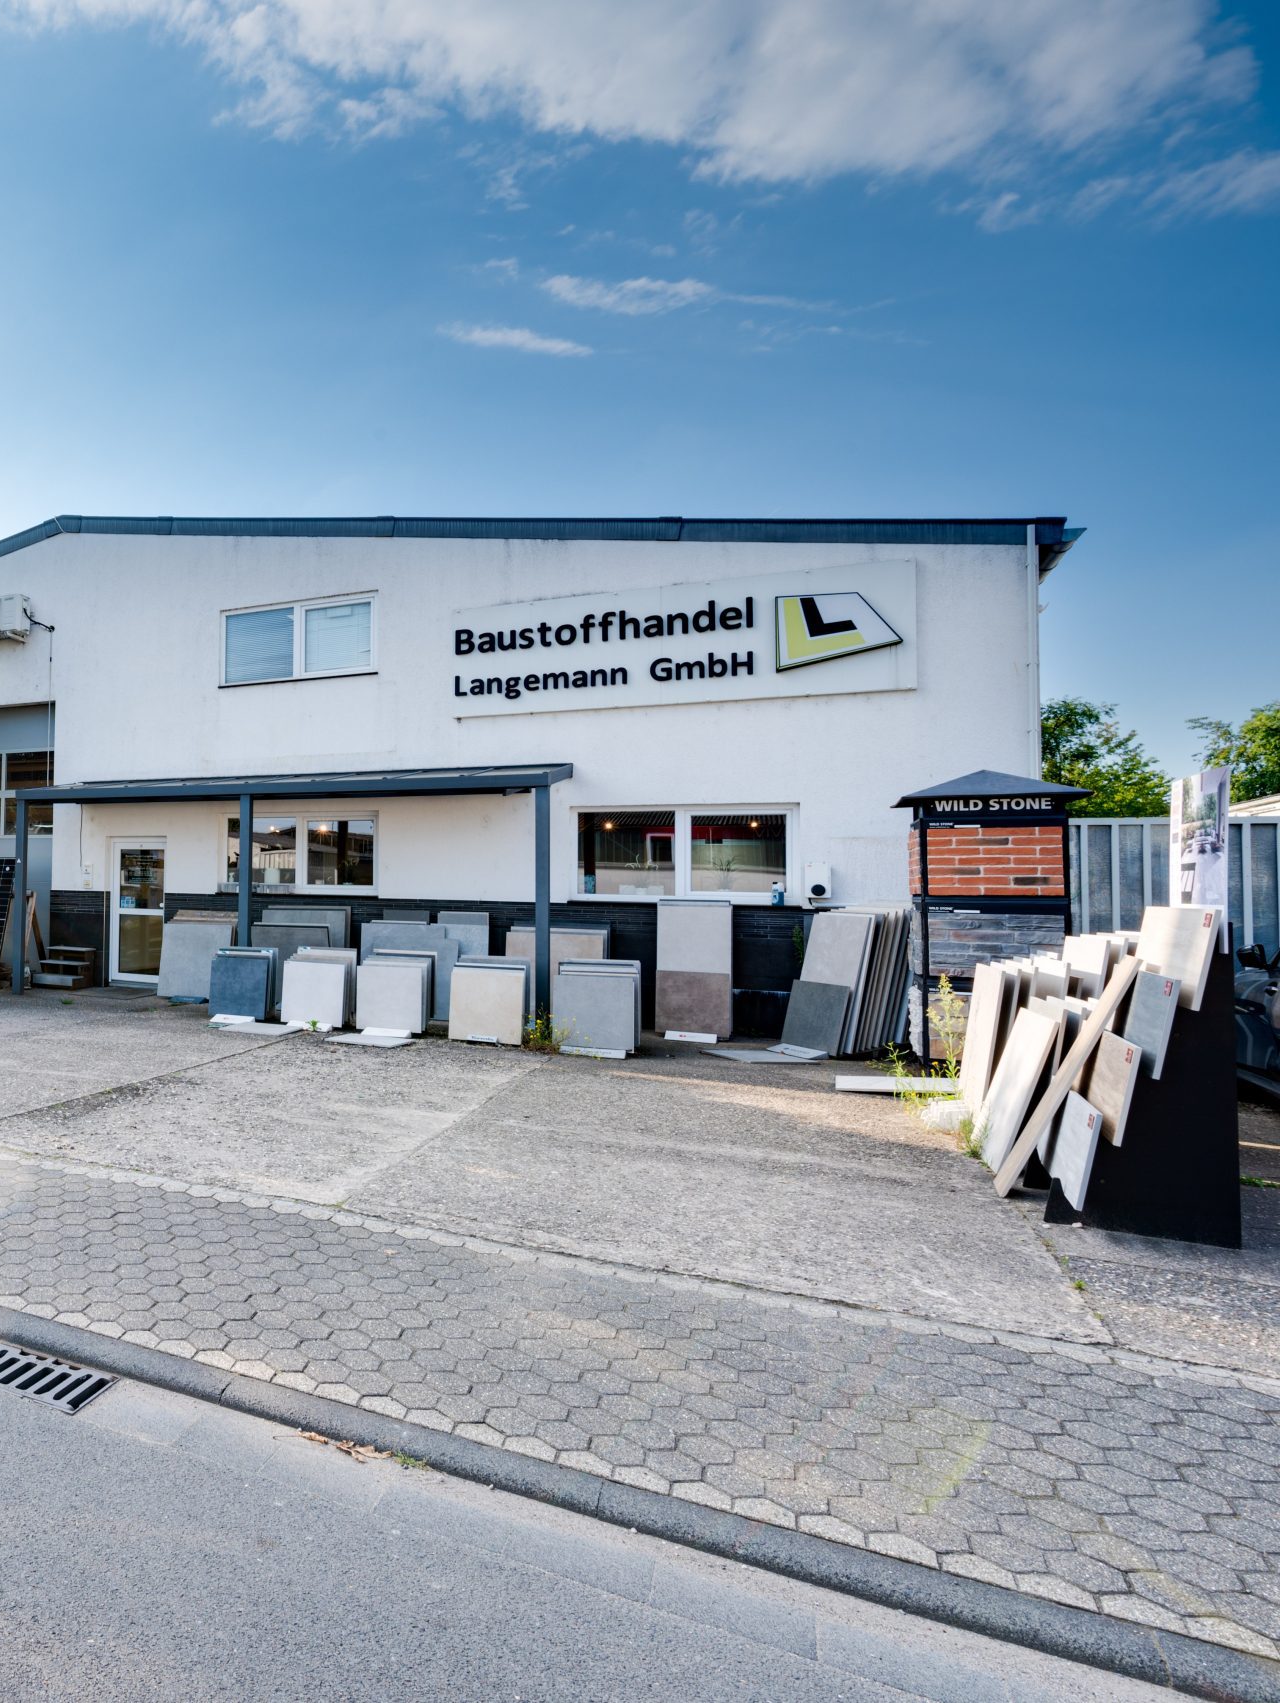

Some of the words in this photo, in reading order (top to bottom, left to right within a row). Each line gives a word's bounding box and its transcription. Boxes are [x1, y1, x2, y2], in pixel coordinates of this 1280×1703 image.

[455, 597, 754, 656] Baustoffhandel
[455, 666, 628, 700] Langemann
[649, 651, 754, 682] GmbH
[935, 799, 983, 812] WILD
[989, 798, 1052, 811] STONE
